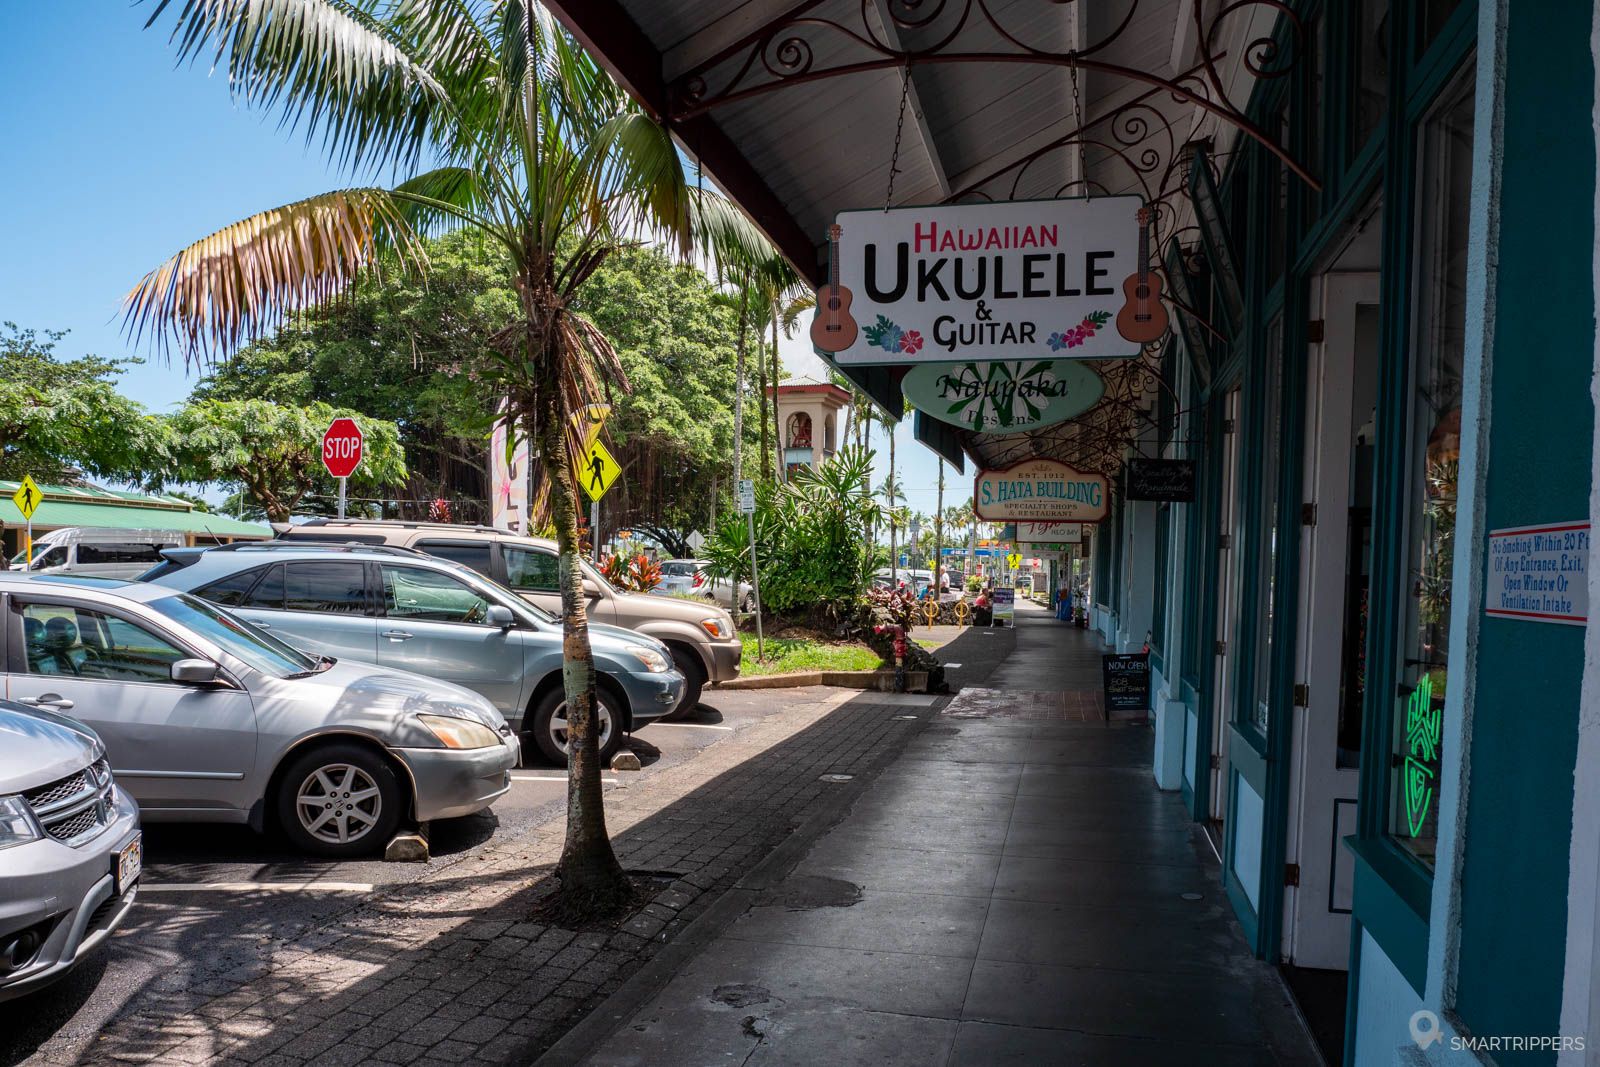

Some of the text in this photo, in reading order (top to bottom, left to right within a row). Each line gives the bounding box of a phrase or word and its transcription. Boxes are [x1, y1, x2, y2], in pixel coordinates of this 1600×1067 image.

[914, 222, 1058, 254] HAWAIIAN
[864, 242, 1115, 304] UKULELE
[975, 300, 992, 321] &
[933, 315, 1037, 352] GUITAR
[935, 369, 1069, 409] Naupaka
[968, 410, 1036, 428] Desgns
[325, 437, 360, 459] STOP
[981, 480, 1102, 508] S. HATA BUILDING
[1492, 541, 1501, 555] No
[1502, 537, 1531, 556] Smoking
[1534, 535, 1561, 552] Within
[1564, 532, 1576, 551] 20
[1494, 553, 1584, 574] Of Any Entrance, Exit,
[1503, 574, 1569, 593] Open Window Or
[1501, 592, 1572, 613] Ventilation Intake
[1108, 660, 1148, 671] NOW OPEN
